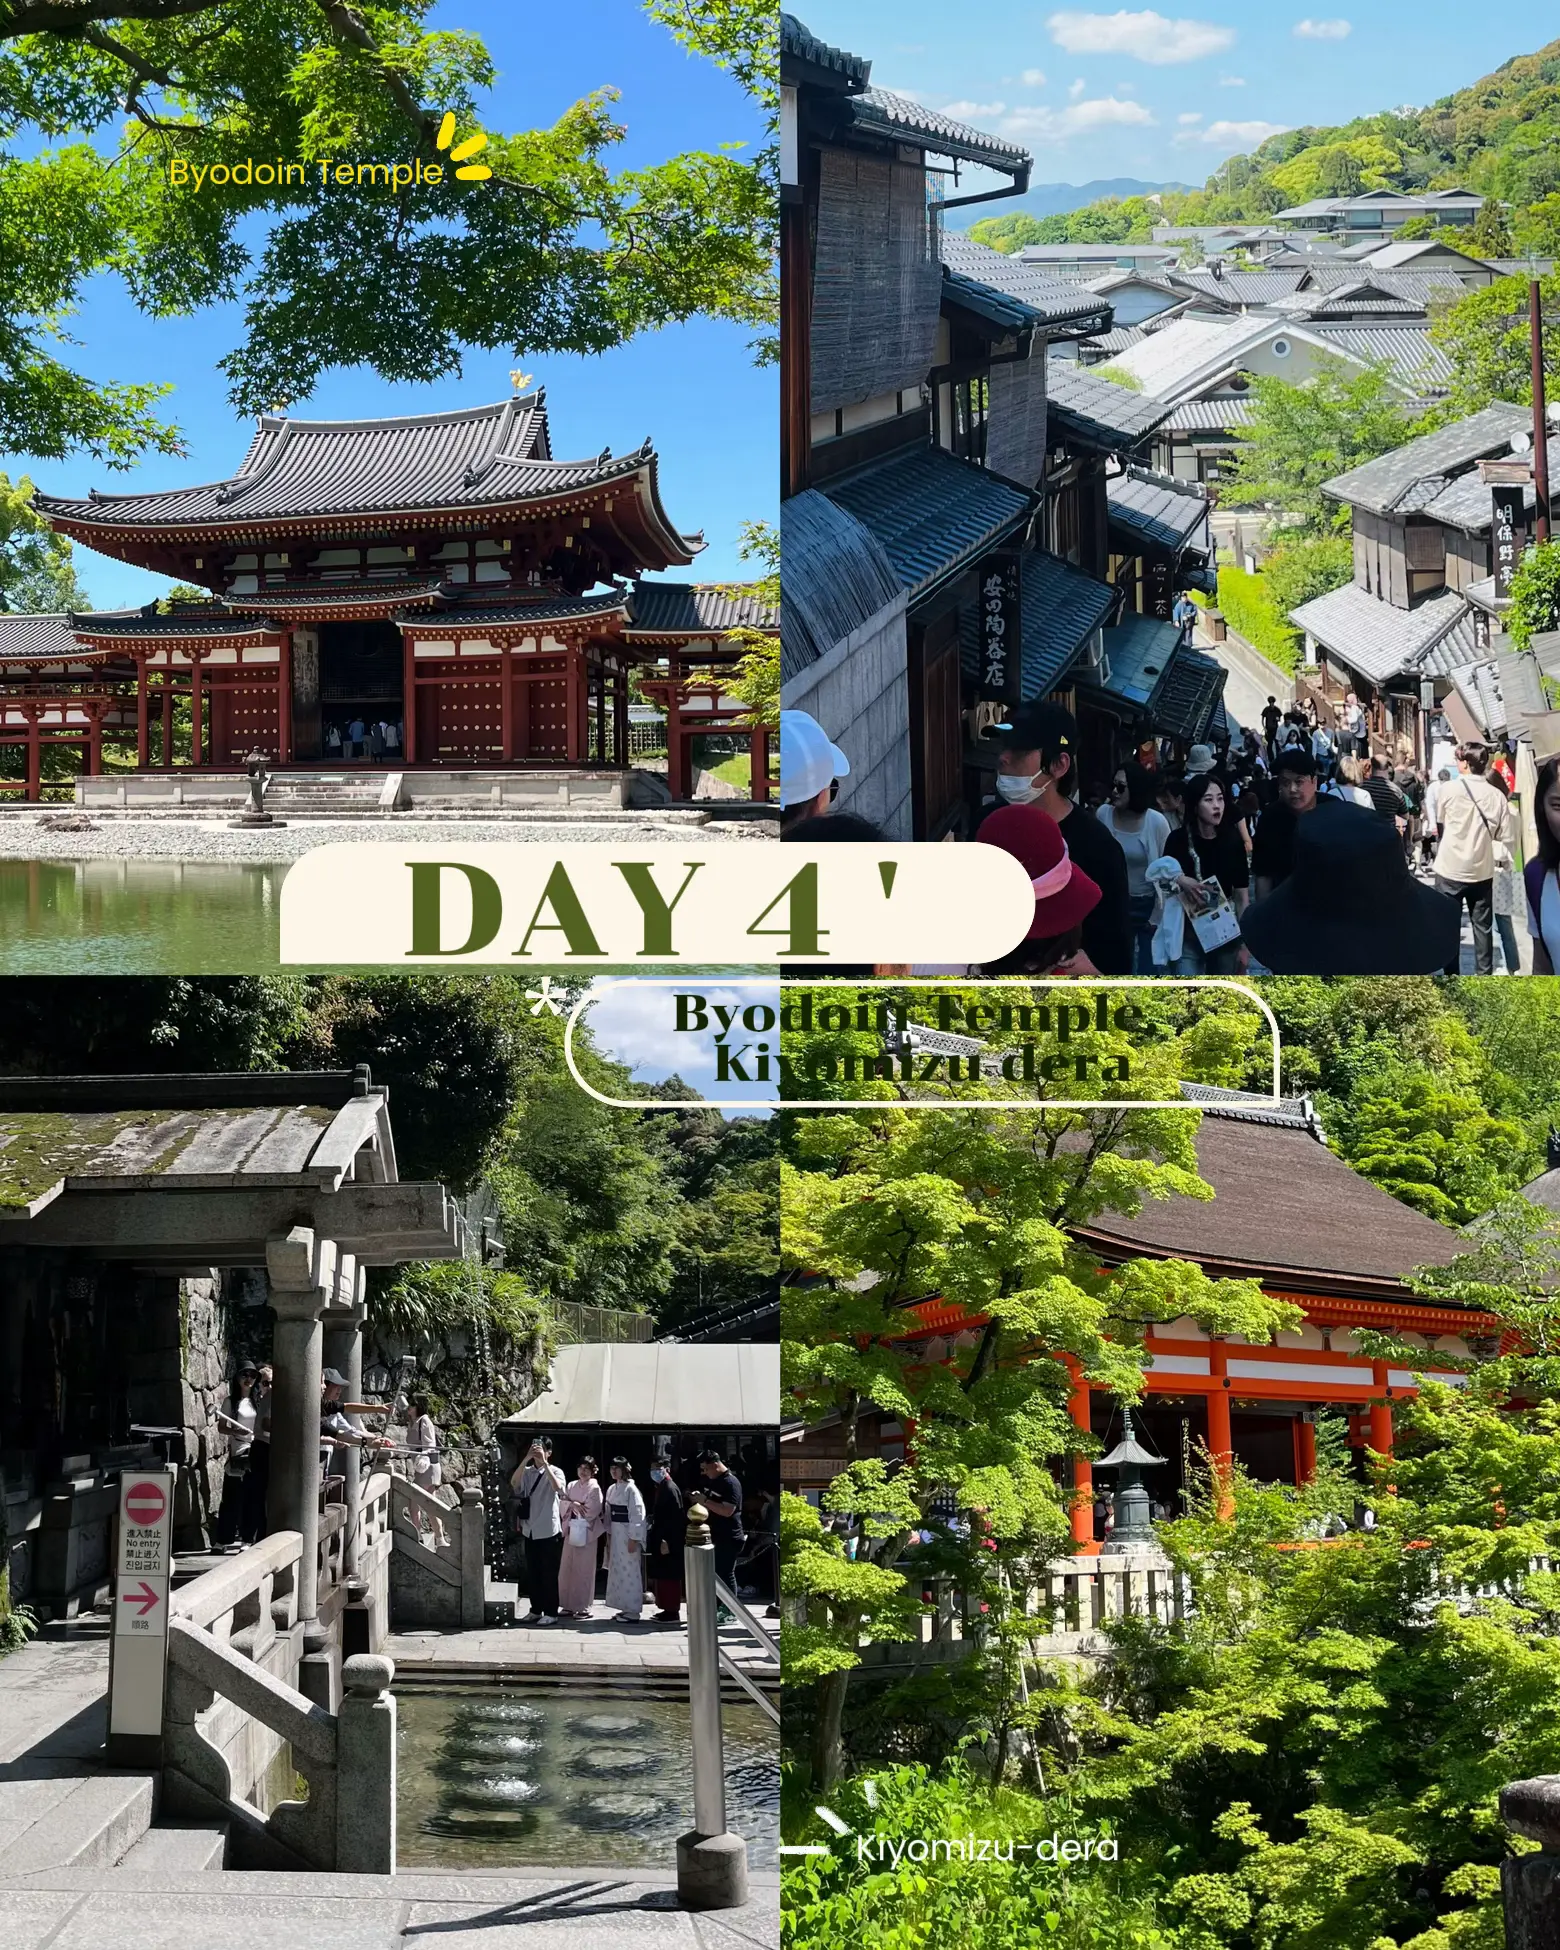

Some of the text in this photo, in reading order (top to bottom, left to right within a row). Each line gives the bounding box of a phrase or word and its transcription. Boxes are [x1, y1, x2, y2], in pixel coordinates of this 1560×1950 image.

[1496, 504, 1514, 587] 明保野亭
[126, 1529, 161, 1539] 進入禁止
[126, 1539, 161, 1550] No entry
[125, 1560, 160, 1571] 진입금지
[131, 1620, 149, 1632] 順路
